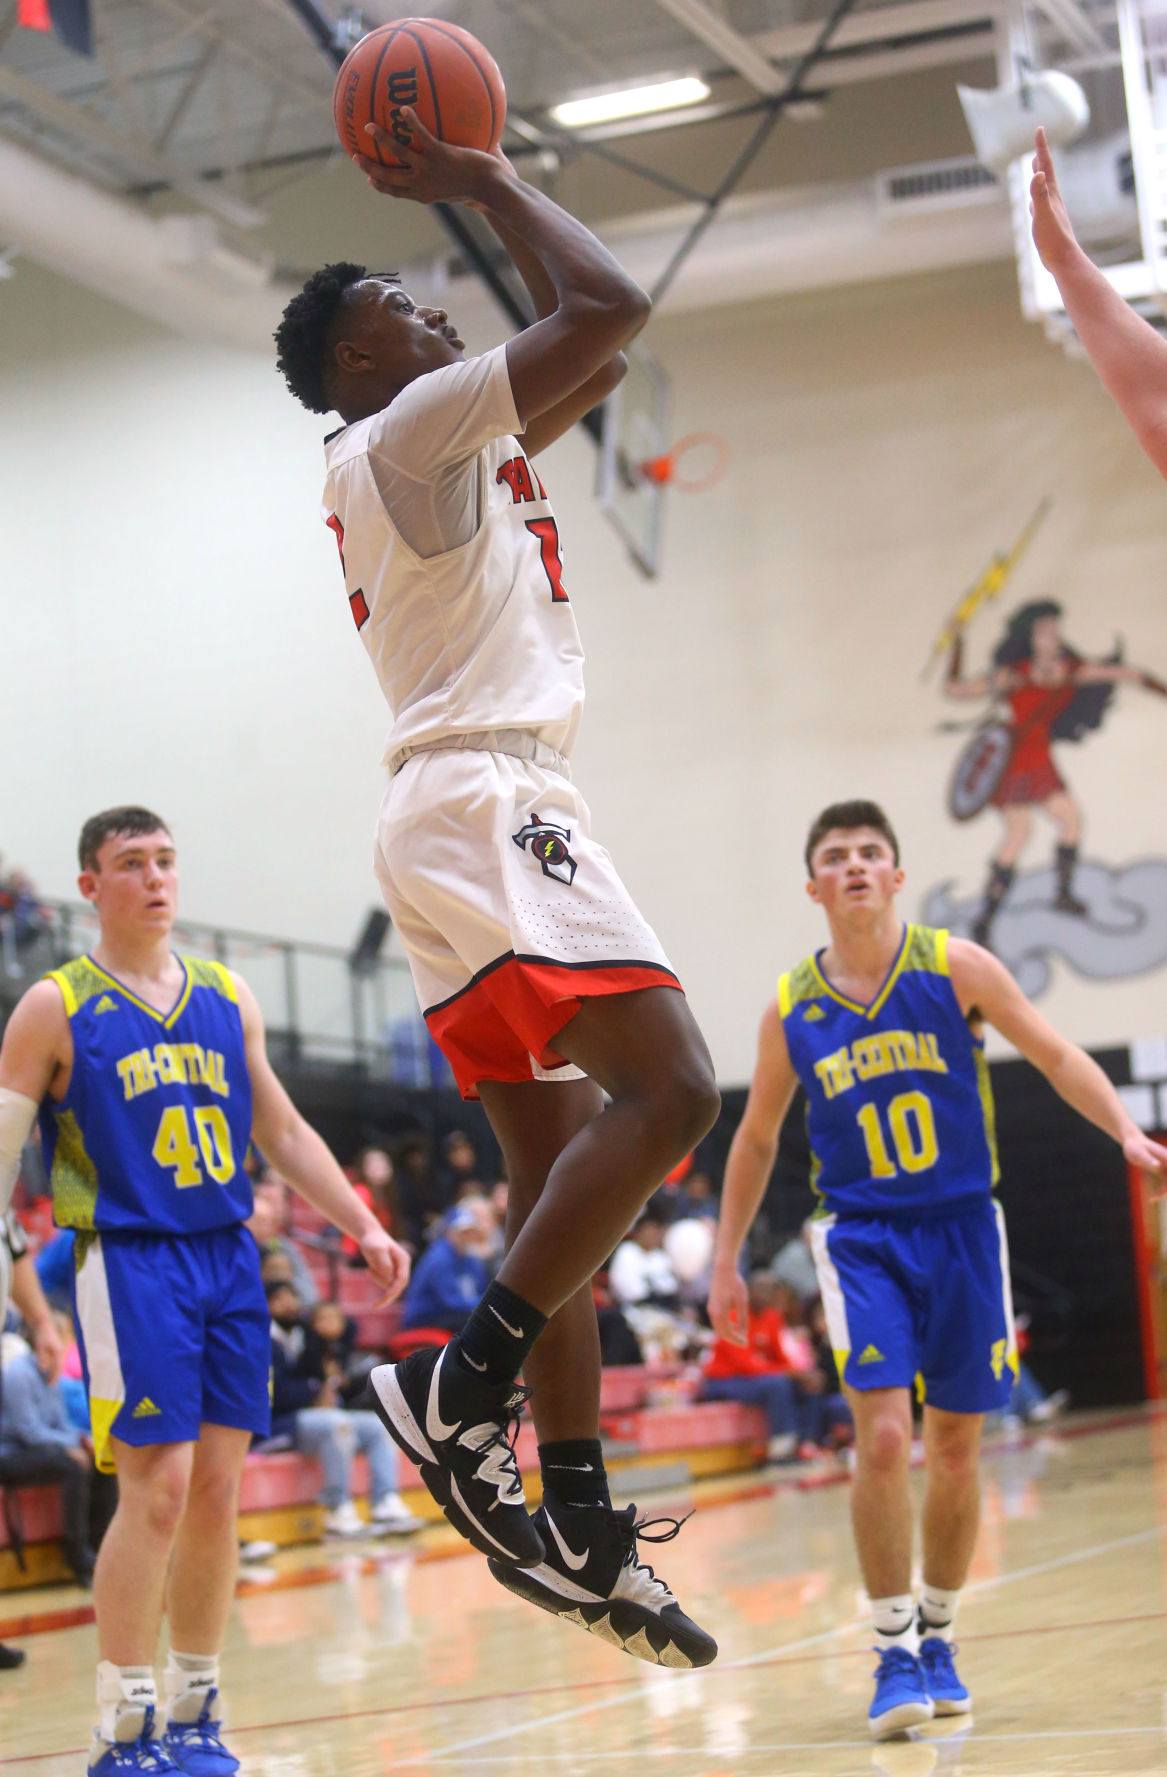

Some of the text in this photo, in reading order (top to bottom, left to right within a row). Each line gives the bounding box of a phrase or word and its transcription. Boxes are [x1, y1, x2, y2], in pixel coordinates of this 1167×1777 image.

[525, 516, 570, 602] 1
[813, 1029, 949, 1101] TRI-CENTRAL
[152, 1104, 237, 1190] 40
[856, 1089, 940, 1179] 10
